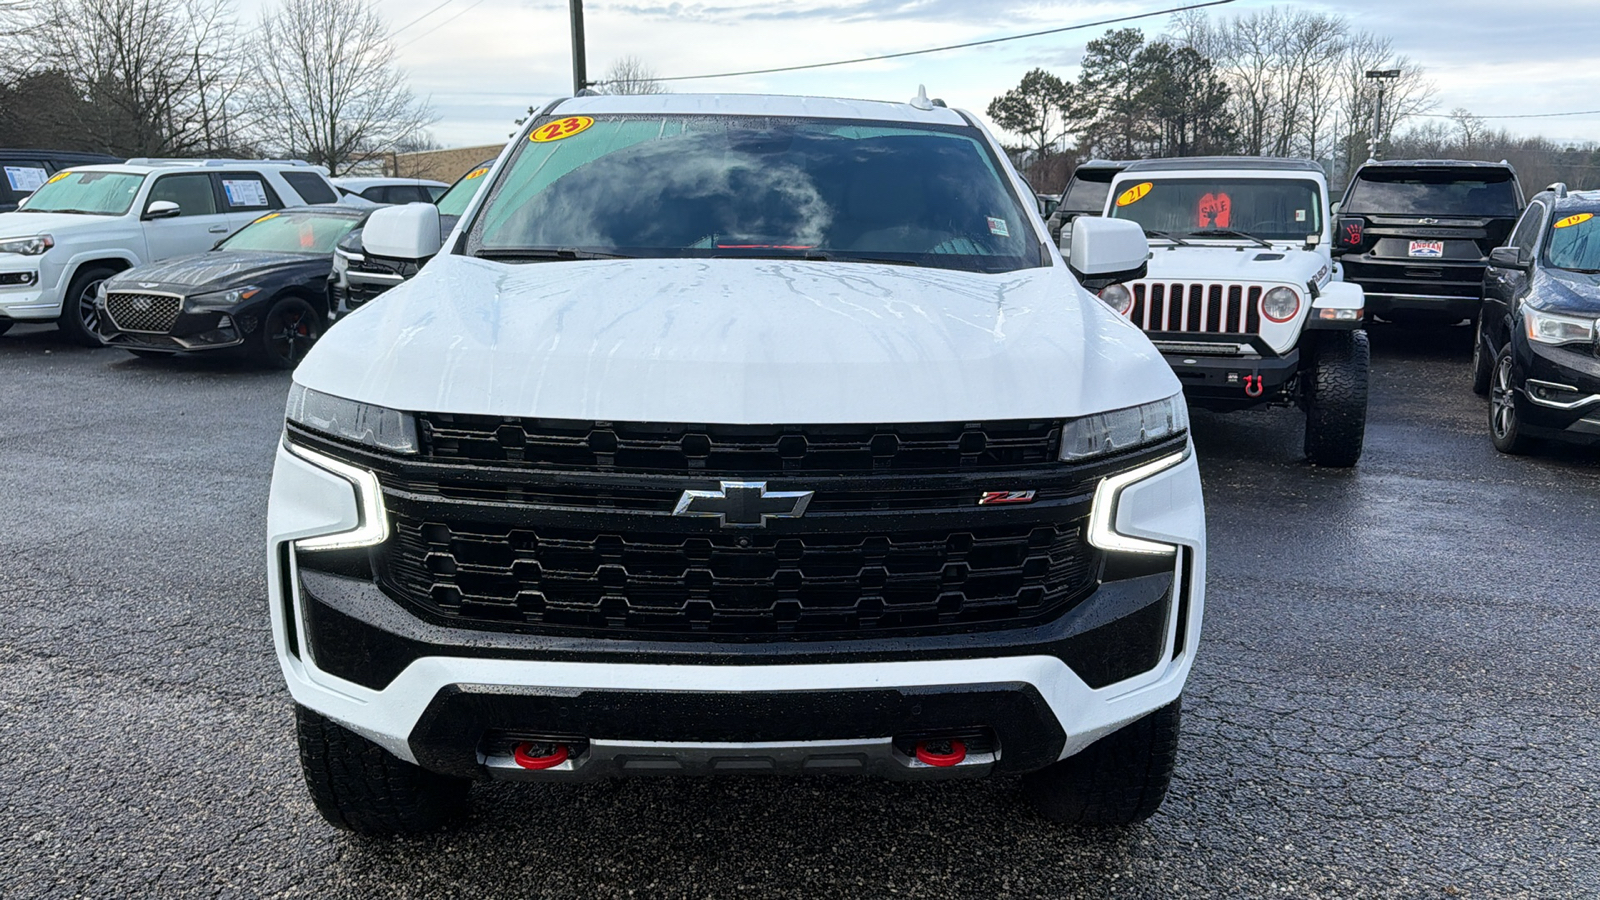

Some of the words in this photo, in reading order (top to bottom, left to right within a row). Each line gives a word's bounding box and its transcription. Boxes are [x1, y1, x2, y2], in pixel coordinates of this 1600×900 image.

[543, 117, 581, 140] 23
[1127, 186, 1141, 203] 21
[1201, 200, 1228, 218] SALE
[1567, 215, 1580, 225] 19
